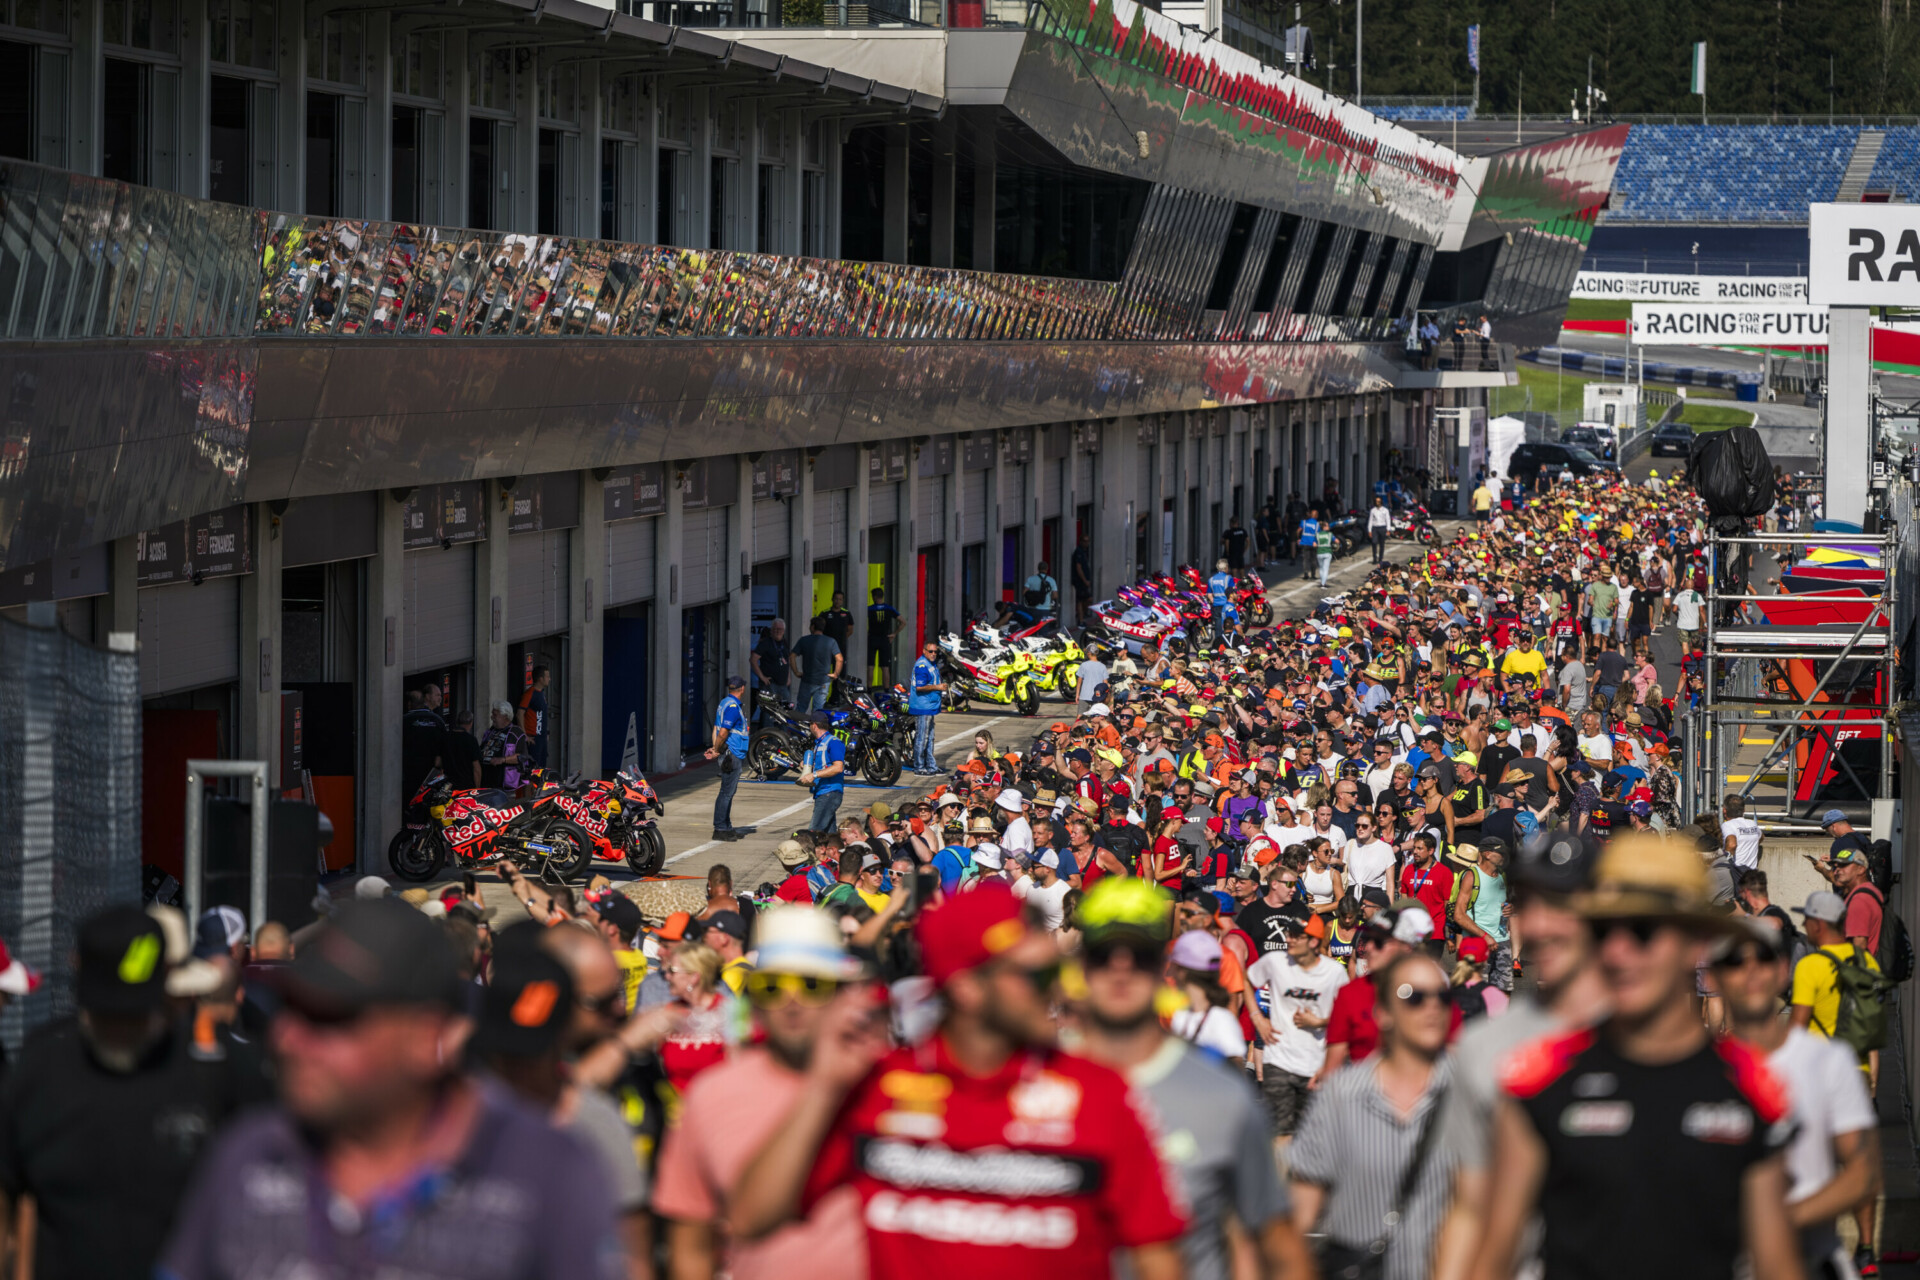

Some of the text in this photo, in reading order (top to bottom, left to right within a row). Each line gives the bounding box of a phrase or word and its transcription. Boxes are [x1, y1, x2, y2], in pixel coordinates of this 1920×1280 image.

[1848, 228, 1920, 283] RA
[1641, 280, 1700, 296] FUTURE
[1718, 282, 1776, 298] RACING
[1646, 313, 1829, 335] RACING FOR THE FUTU
[442, 804, 525, 846] Red Bull
[1168, 844, 1182, 861] 93
